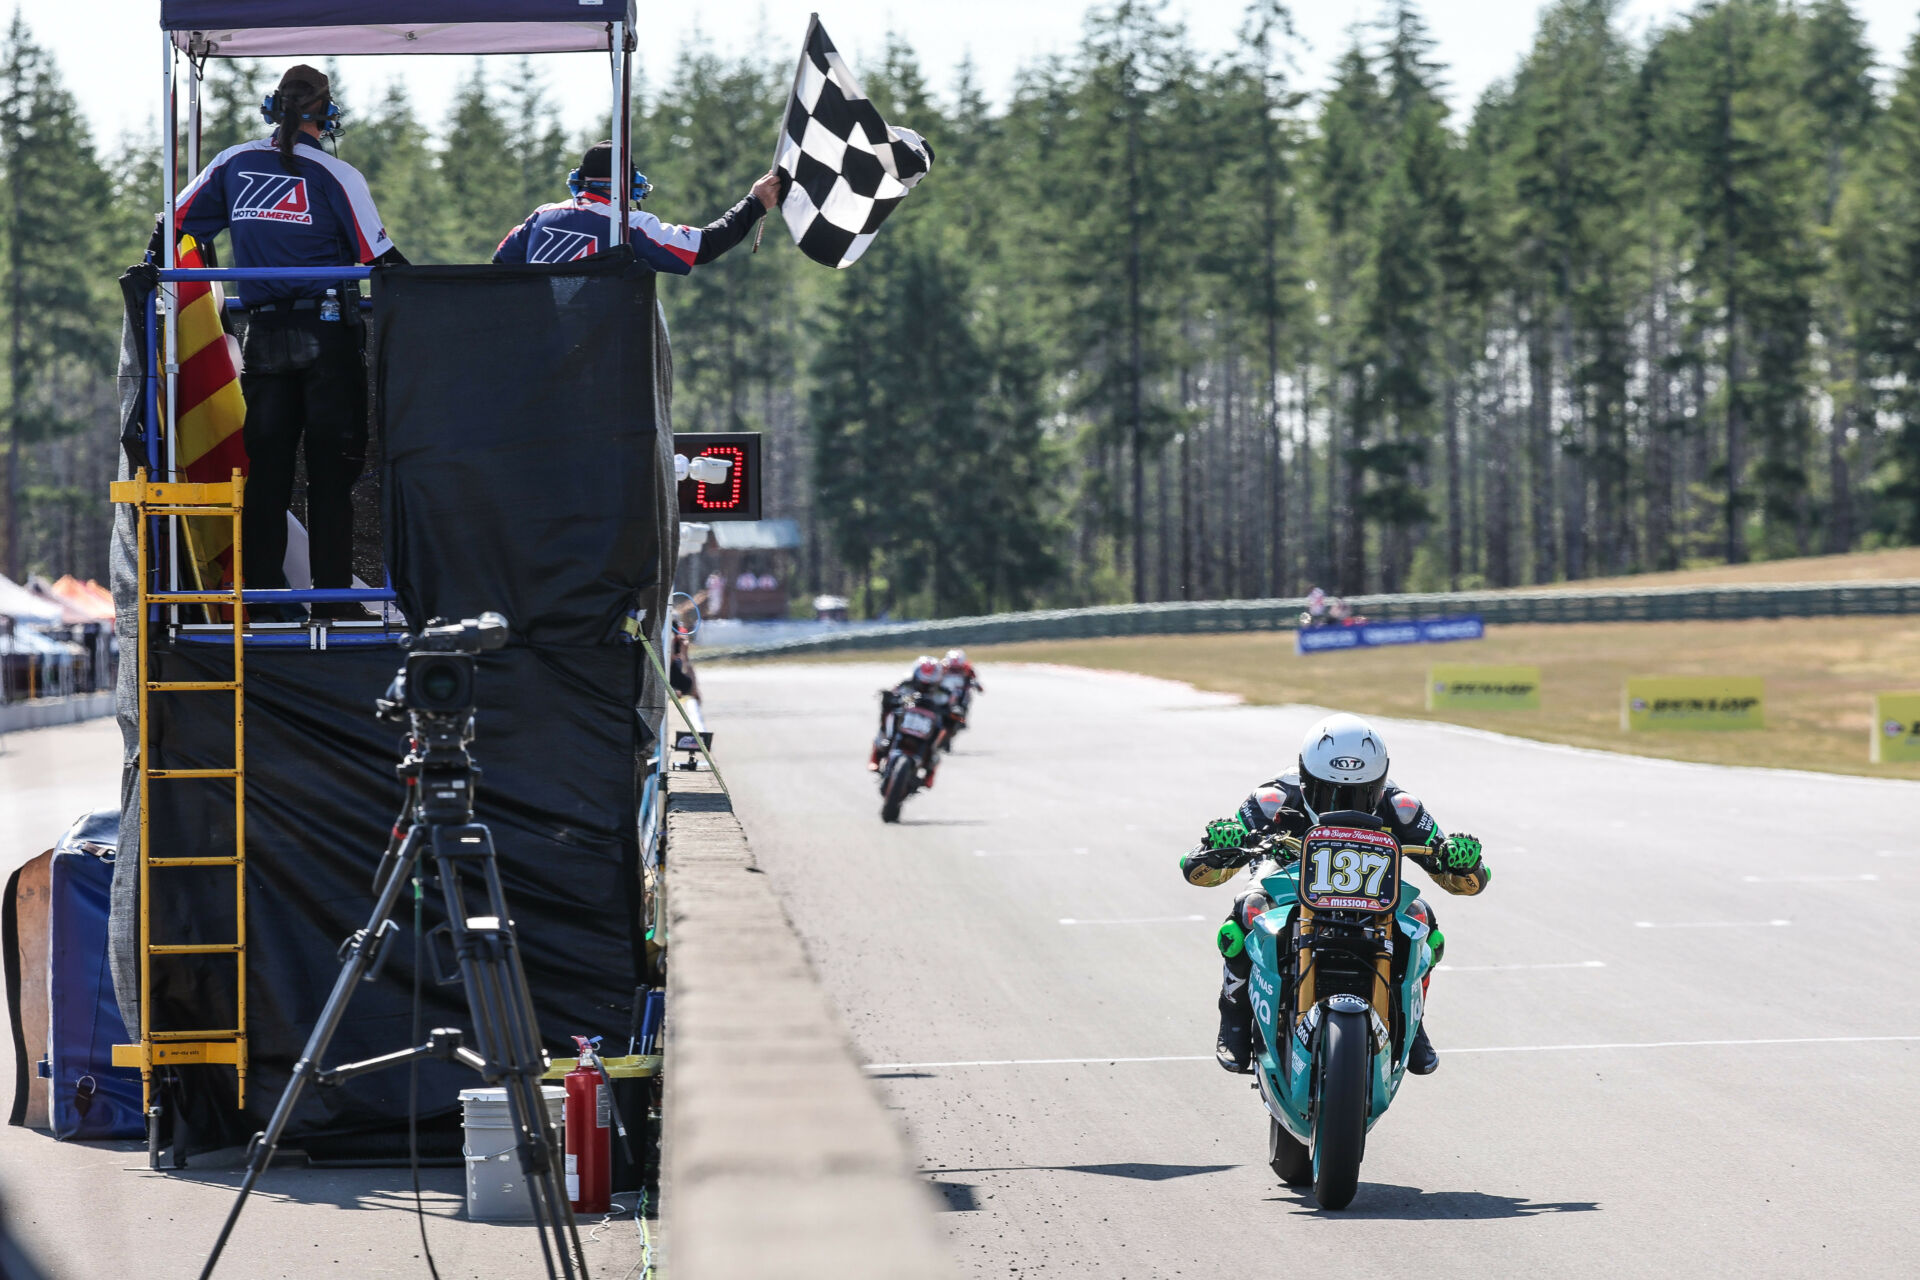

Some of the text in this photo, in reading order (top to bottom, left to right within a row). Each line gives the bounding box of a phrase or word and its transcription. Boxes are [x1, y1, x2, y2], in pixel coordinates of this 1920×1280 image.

[233, 210, 311, 223] MOTOAMERICA
[1332, 758, 1362, 769] KYT
[1331, 829, 1384, 843] Super Hooligan
[1310, 848, 1390, 896] 137
[1330, 898, 1368, 908] MISSION
